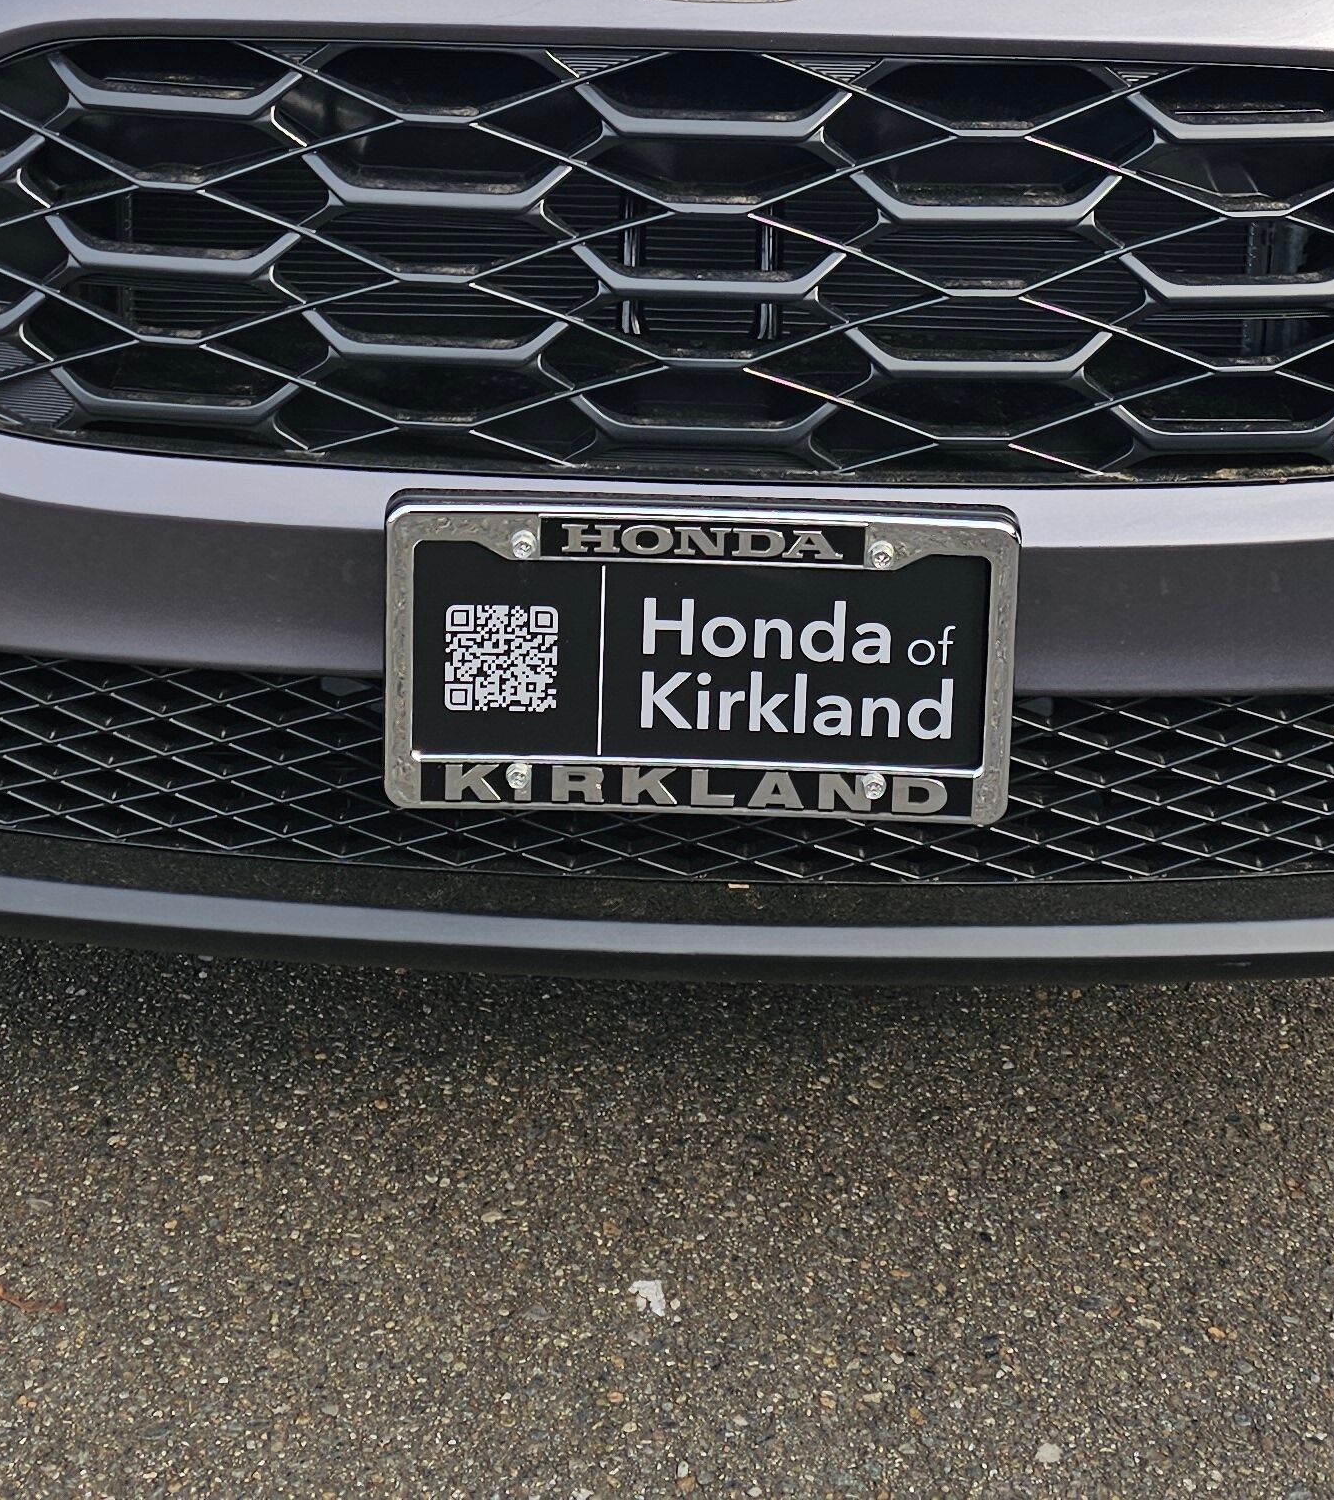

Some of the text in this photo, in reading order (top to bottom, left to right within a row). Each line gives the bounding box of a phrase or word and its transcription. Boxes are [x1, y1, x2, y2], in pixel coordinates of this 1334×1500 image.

[561, 523, 844, 560] HONDA
[642, 596, 957, 666] Honda of
[640, 670, 955, 740] Kirkland
[444, 763, 948, 815] KIRKLAND
